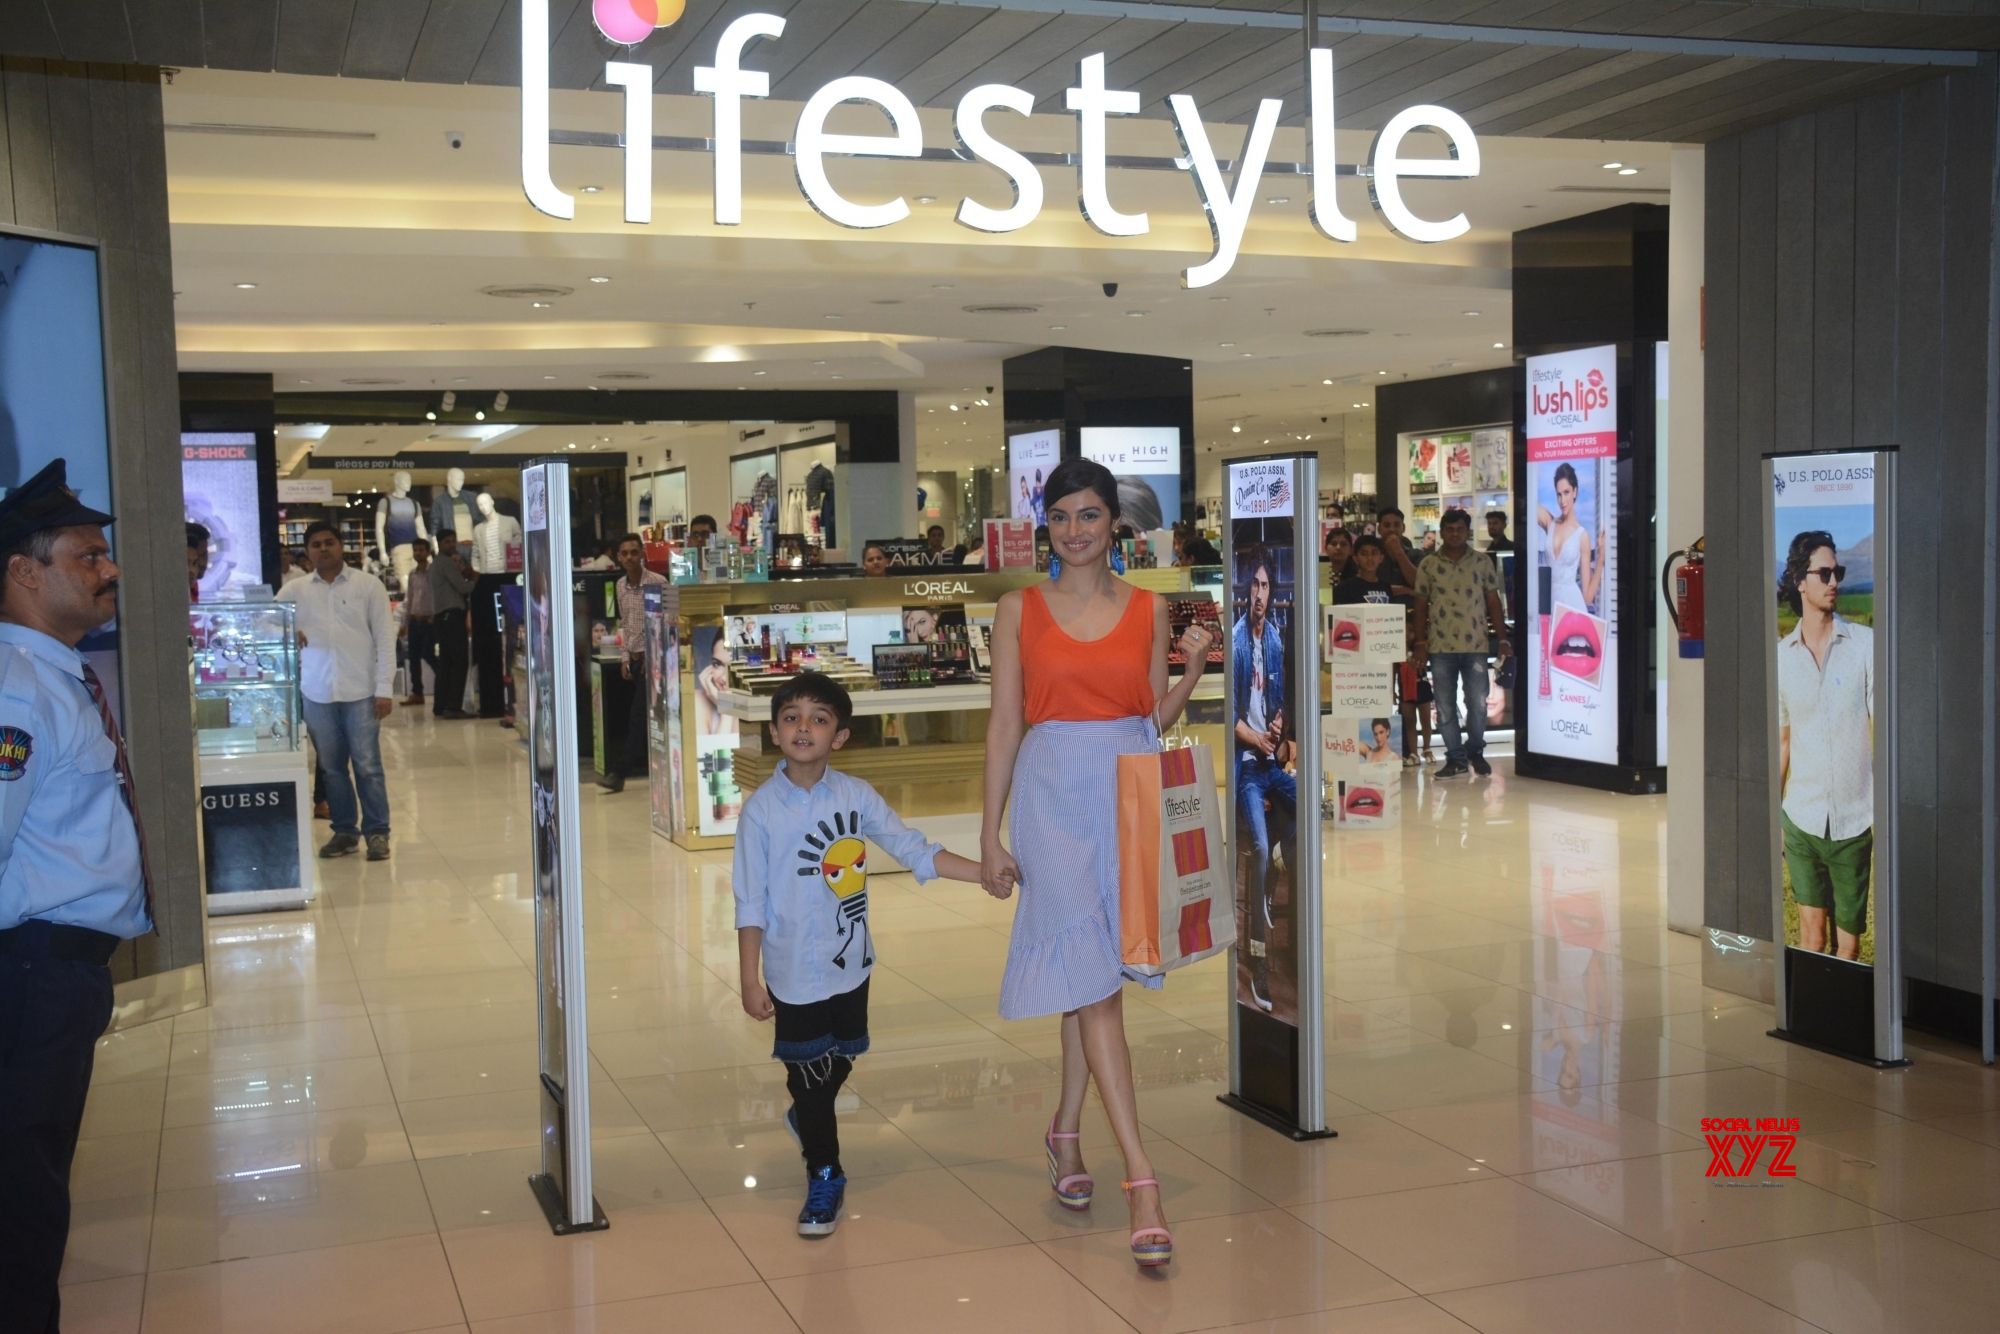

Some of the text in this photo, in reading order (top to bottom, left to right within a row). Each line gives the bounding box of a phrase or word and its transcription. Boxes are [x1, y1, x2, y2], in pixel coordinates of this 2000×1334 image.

[521, 0, 1481, 289] lifestyle
[1533, 379, 1609, 421] lush lips
[1019, 440, 1049, 460] LIVE HIGH
[1544, 437, 1597, 448] EXCITING OFFERS
[184, 447, 246, 459] G-SHOCK
[1092, 446, 1168, 463] LIVE HIGH
[335, 459, 367, 469] please
[393, 460, 415, 468] here
[1240, 469, 1250, 478] U.S.
[1250, 466, 1266, 476] POLO
[1789, 471, 1809, 482] U.S.
[1812, 470, 1843, 482] POLO
[904, 579, 975, 596] L'ORÉAL
[1560, 694, 1586, 704] CANNES
[203, 791, 280, 810] GUESS
[1165, 795, 1201, 817] lifestyle
